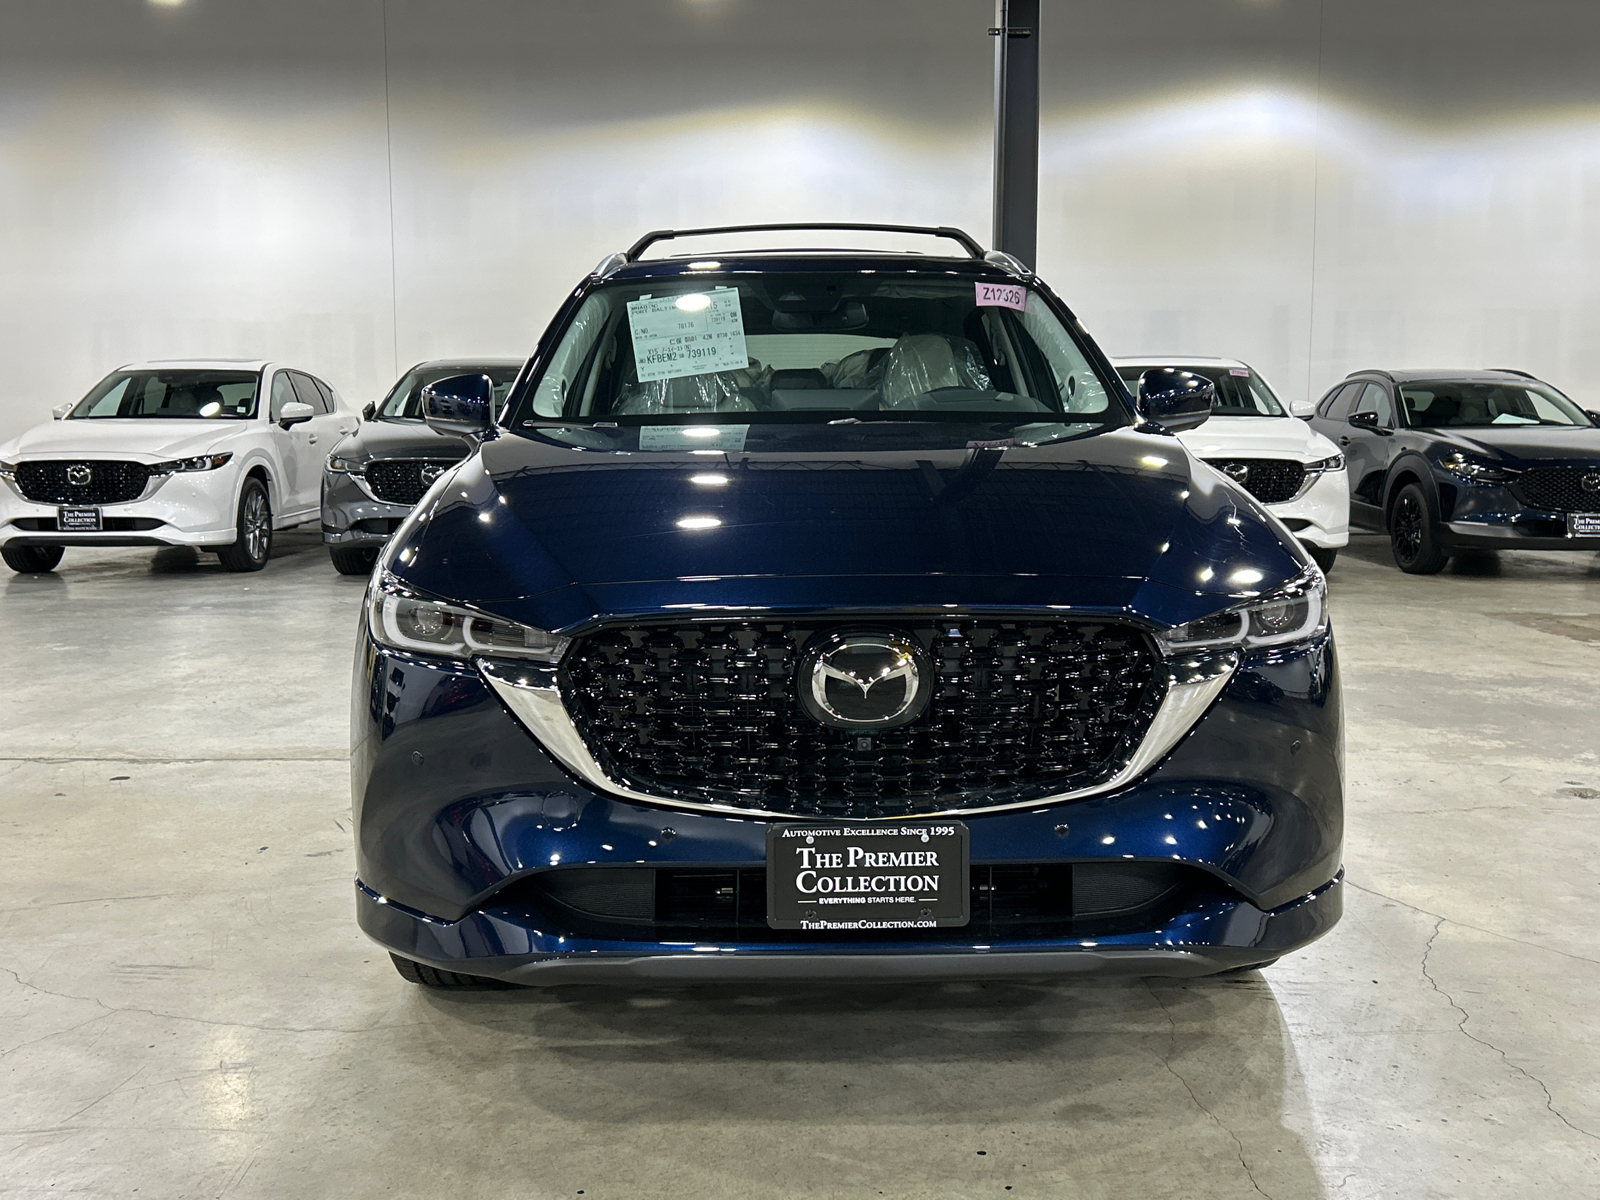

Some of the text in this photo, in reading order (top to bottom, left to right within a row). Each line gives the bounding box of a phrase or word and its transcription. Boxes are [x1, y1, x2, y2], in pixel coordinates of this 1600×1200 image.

[647, 352, 678, 364] KFBEM2
[687, 347, 717, 358] 739119
[782, 826, 955, 838] AUTOMOTIVE EXCELLENCE SINCE 1995
[795, 846, 940, 869] THE PREMIER
[795, 870, 940, 894] COLLECTION
[818, 897, 866, 905] EVERYTHING
[894, 896, 917, 904] HERE.
[800, 919, 937, 930] THEPREMIERCOLLECTION.COM
